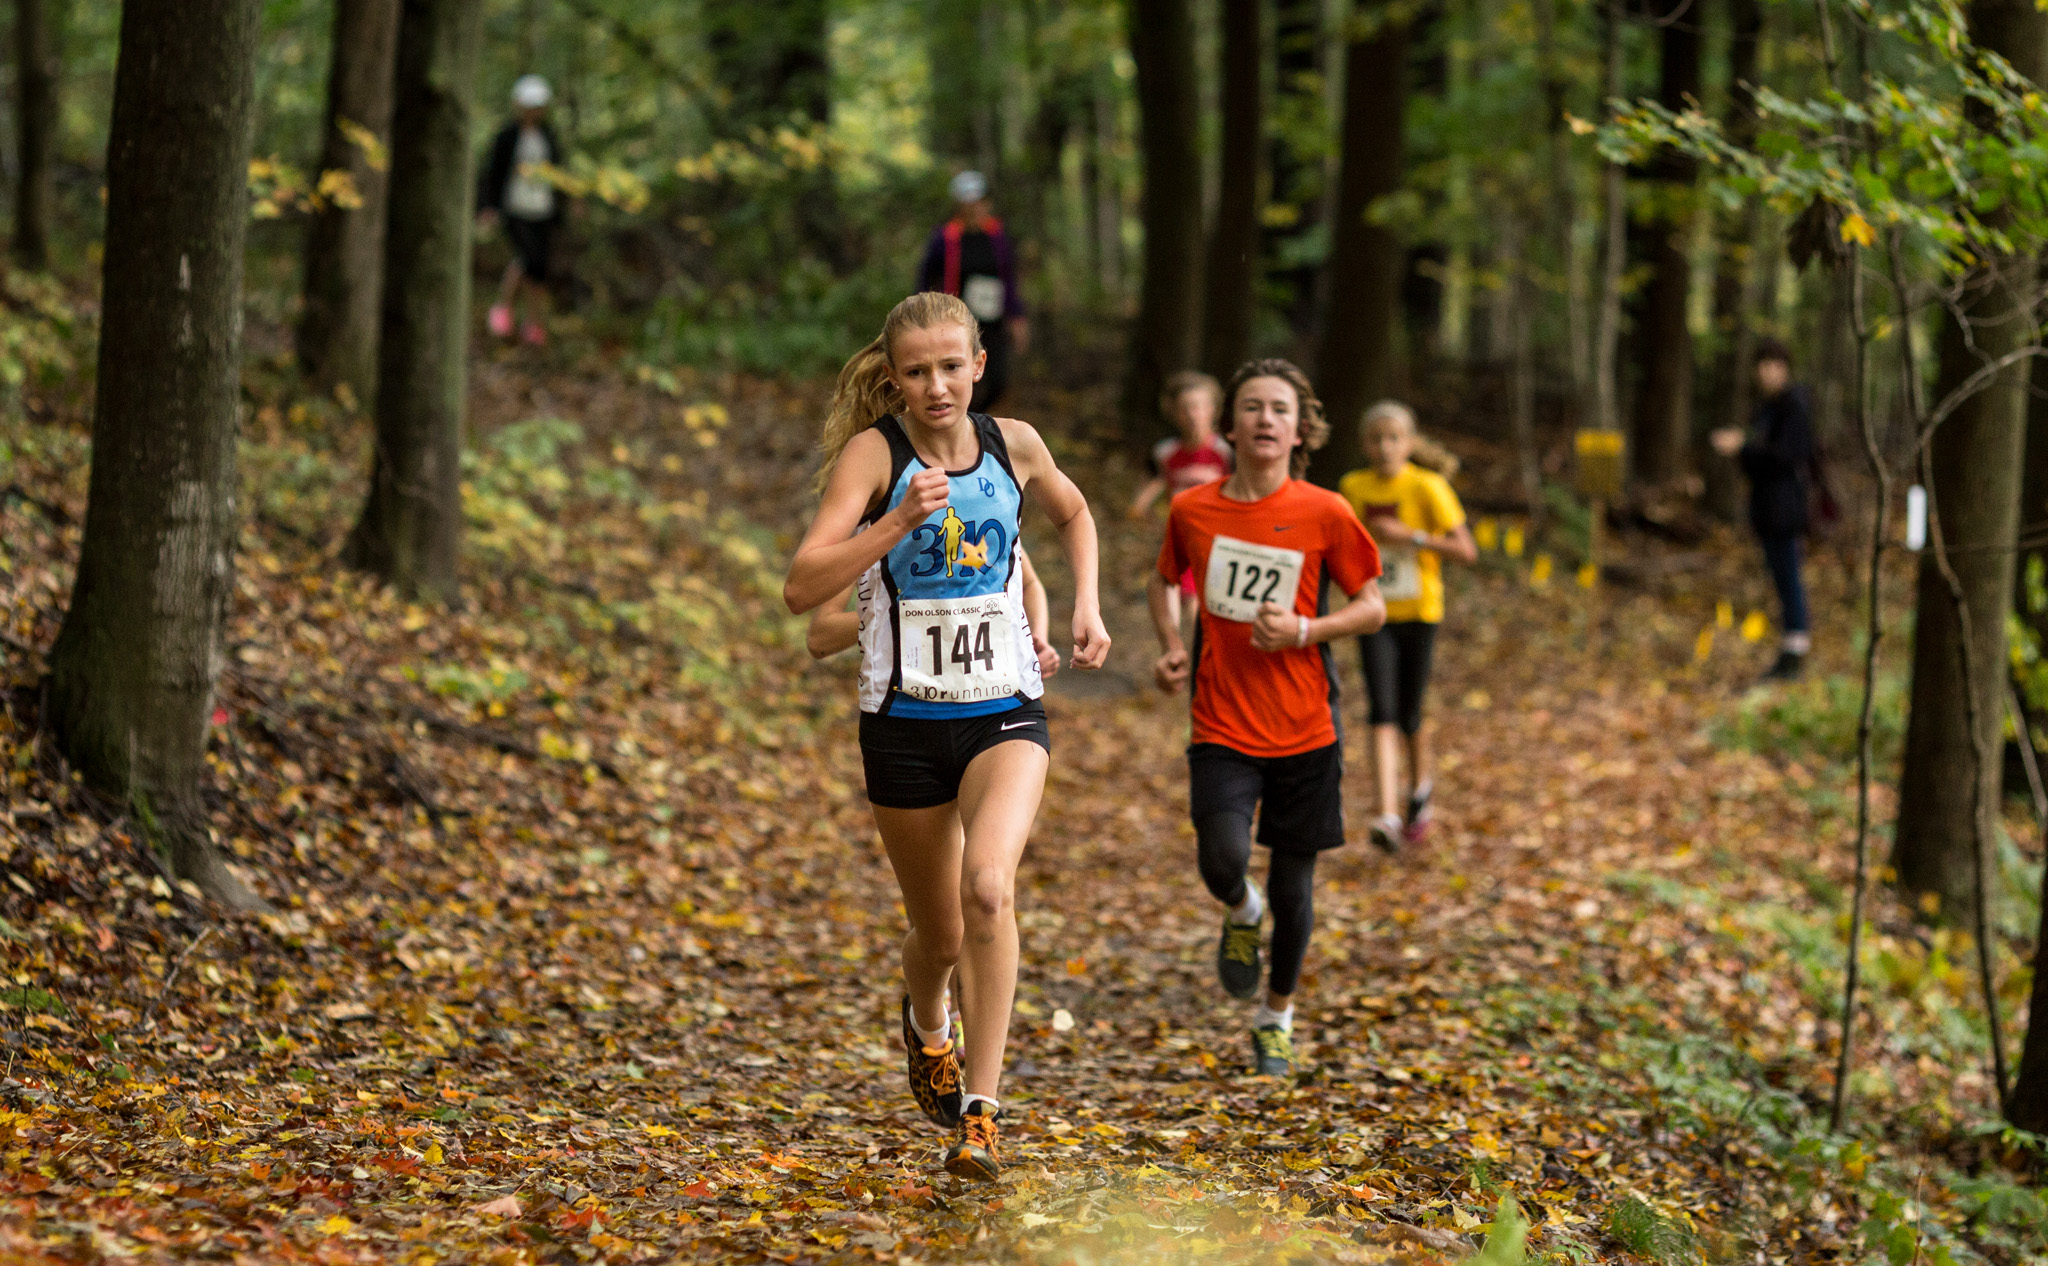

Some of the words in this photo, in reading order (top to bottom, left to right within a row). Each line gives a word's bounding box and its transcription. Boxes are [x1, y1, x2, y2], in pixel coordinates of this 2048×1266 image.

[1226, 560, 1281, 603] 122
[905, 609, 924, 617] DON
[924, 609, 952, 617] OLSON
[953, 606, 981, 615] CLASSIC
[926, 621, 994, 676] 144
